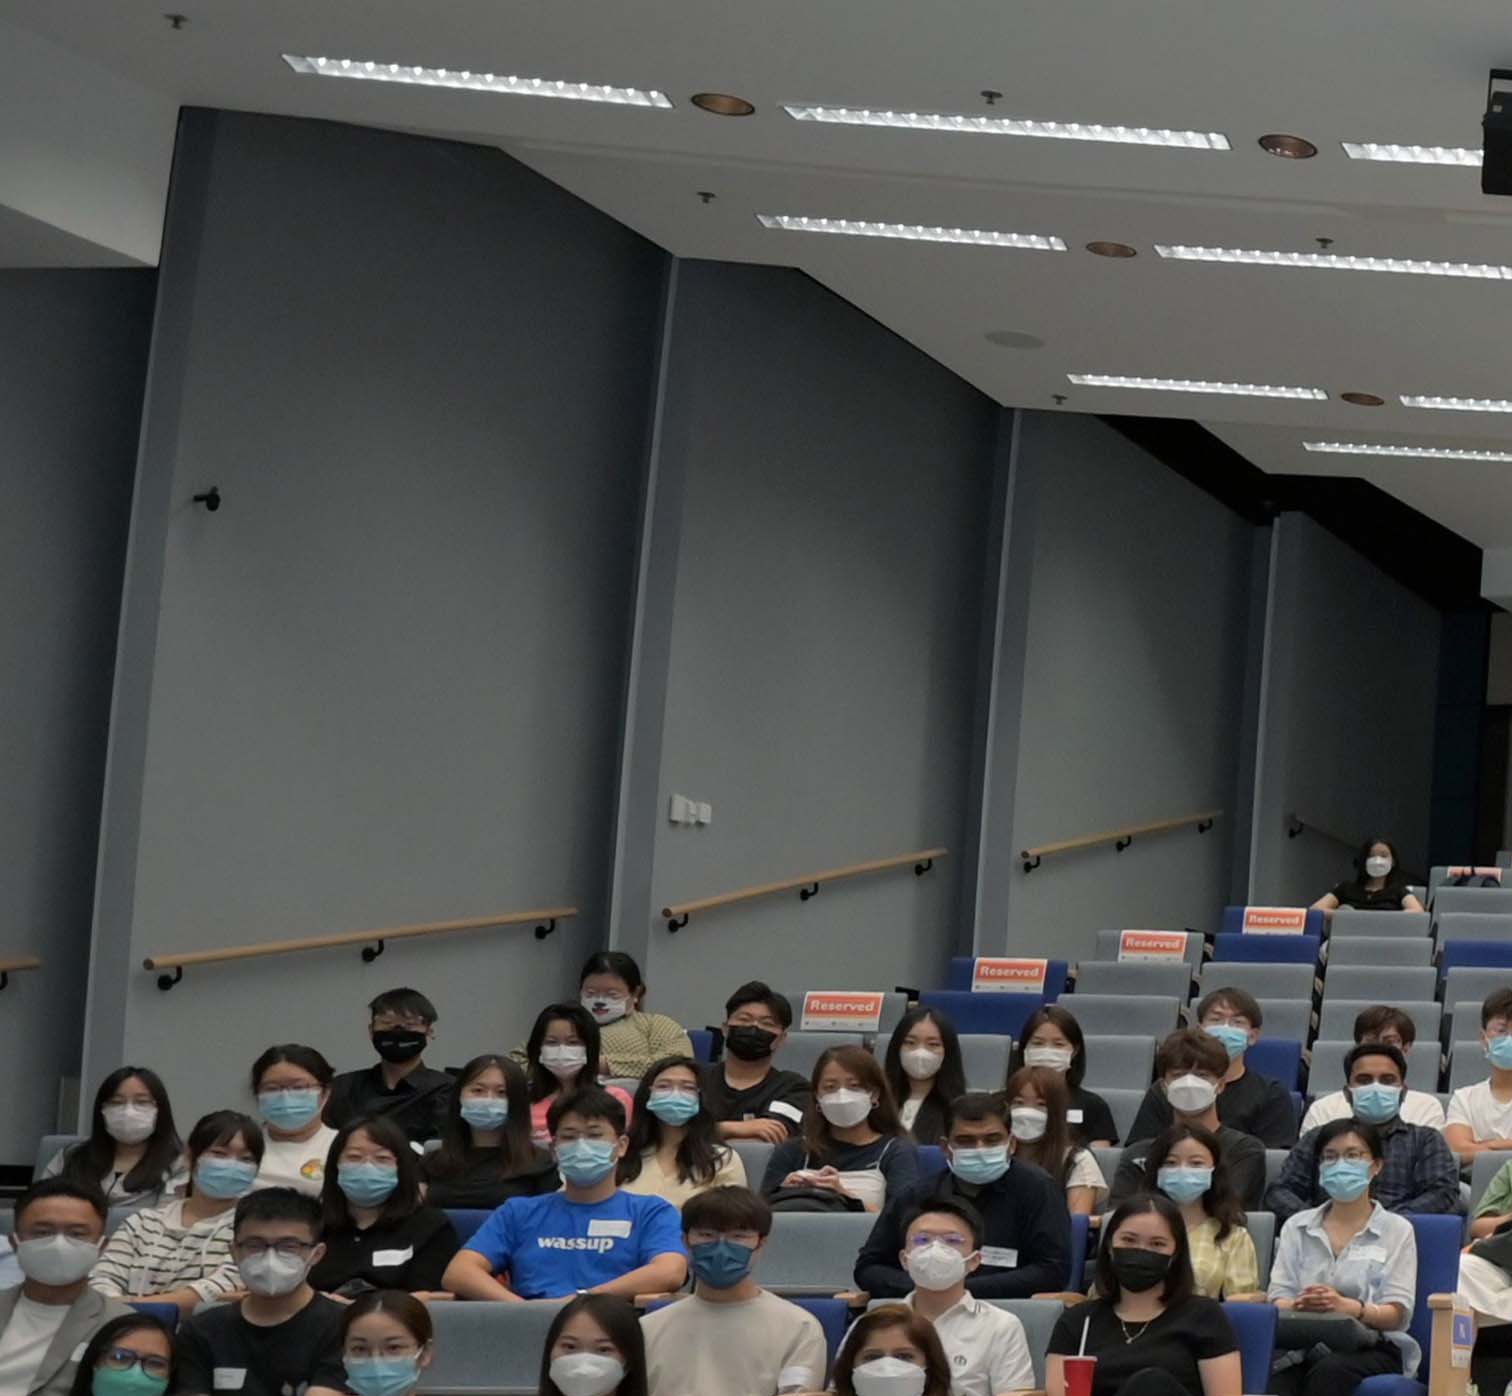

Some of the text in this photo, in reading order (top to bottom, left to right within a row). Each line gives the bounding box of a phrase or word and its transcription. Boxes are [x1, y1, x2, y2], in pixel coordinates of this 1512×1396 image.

[1125, 938, 1180, 950] Reserved
[980, 965, 1039, 979] Reserved
[810, 998, 876, 1013] Reserved
[537, 1237, 614, 1255] wassup
